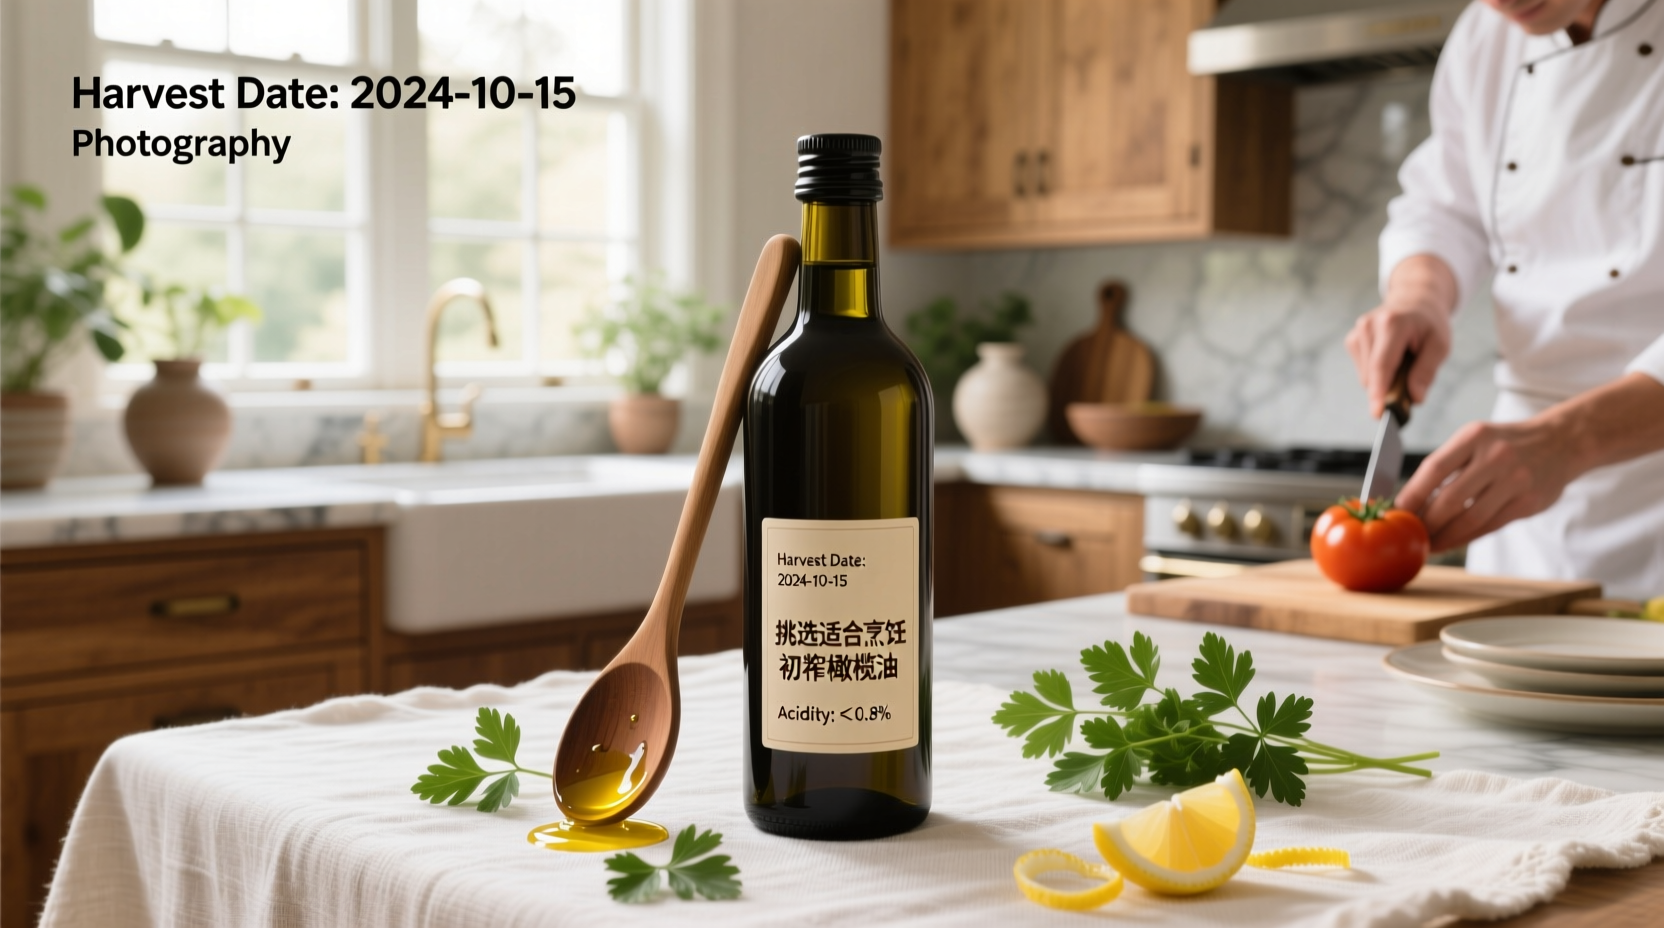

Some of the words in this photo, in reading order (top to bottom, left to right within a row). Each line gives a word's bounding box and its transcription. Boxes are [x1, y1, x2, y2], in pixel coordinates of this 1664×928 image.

[777, 552, 827, 567] Harvest
[830, 553, 866, 568] Date:
[777, 573, 848, 588] 2024-10-15
[775, 619, 907, 648] 挑选适合烹饪
[777, 705, 835, 726] Acidity:
